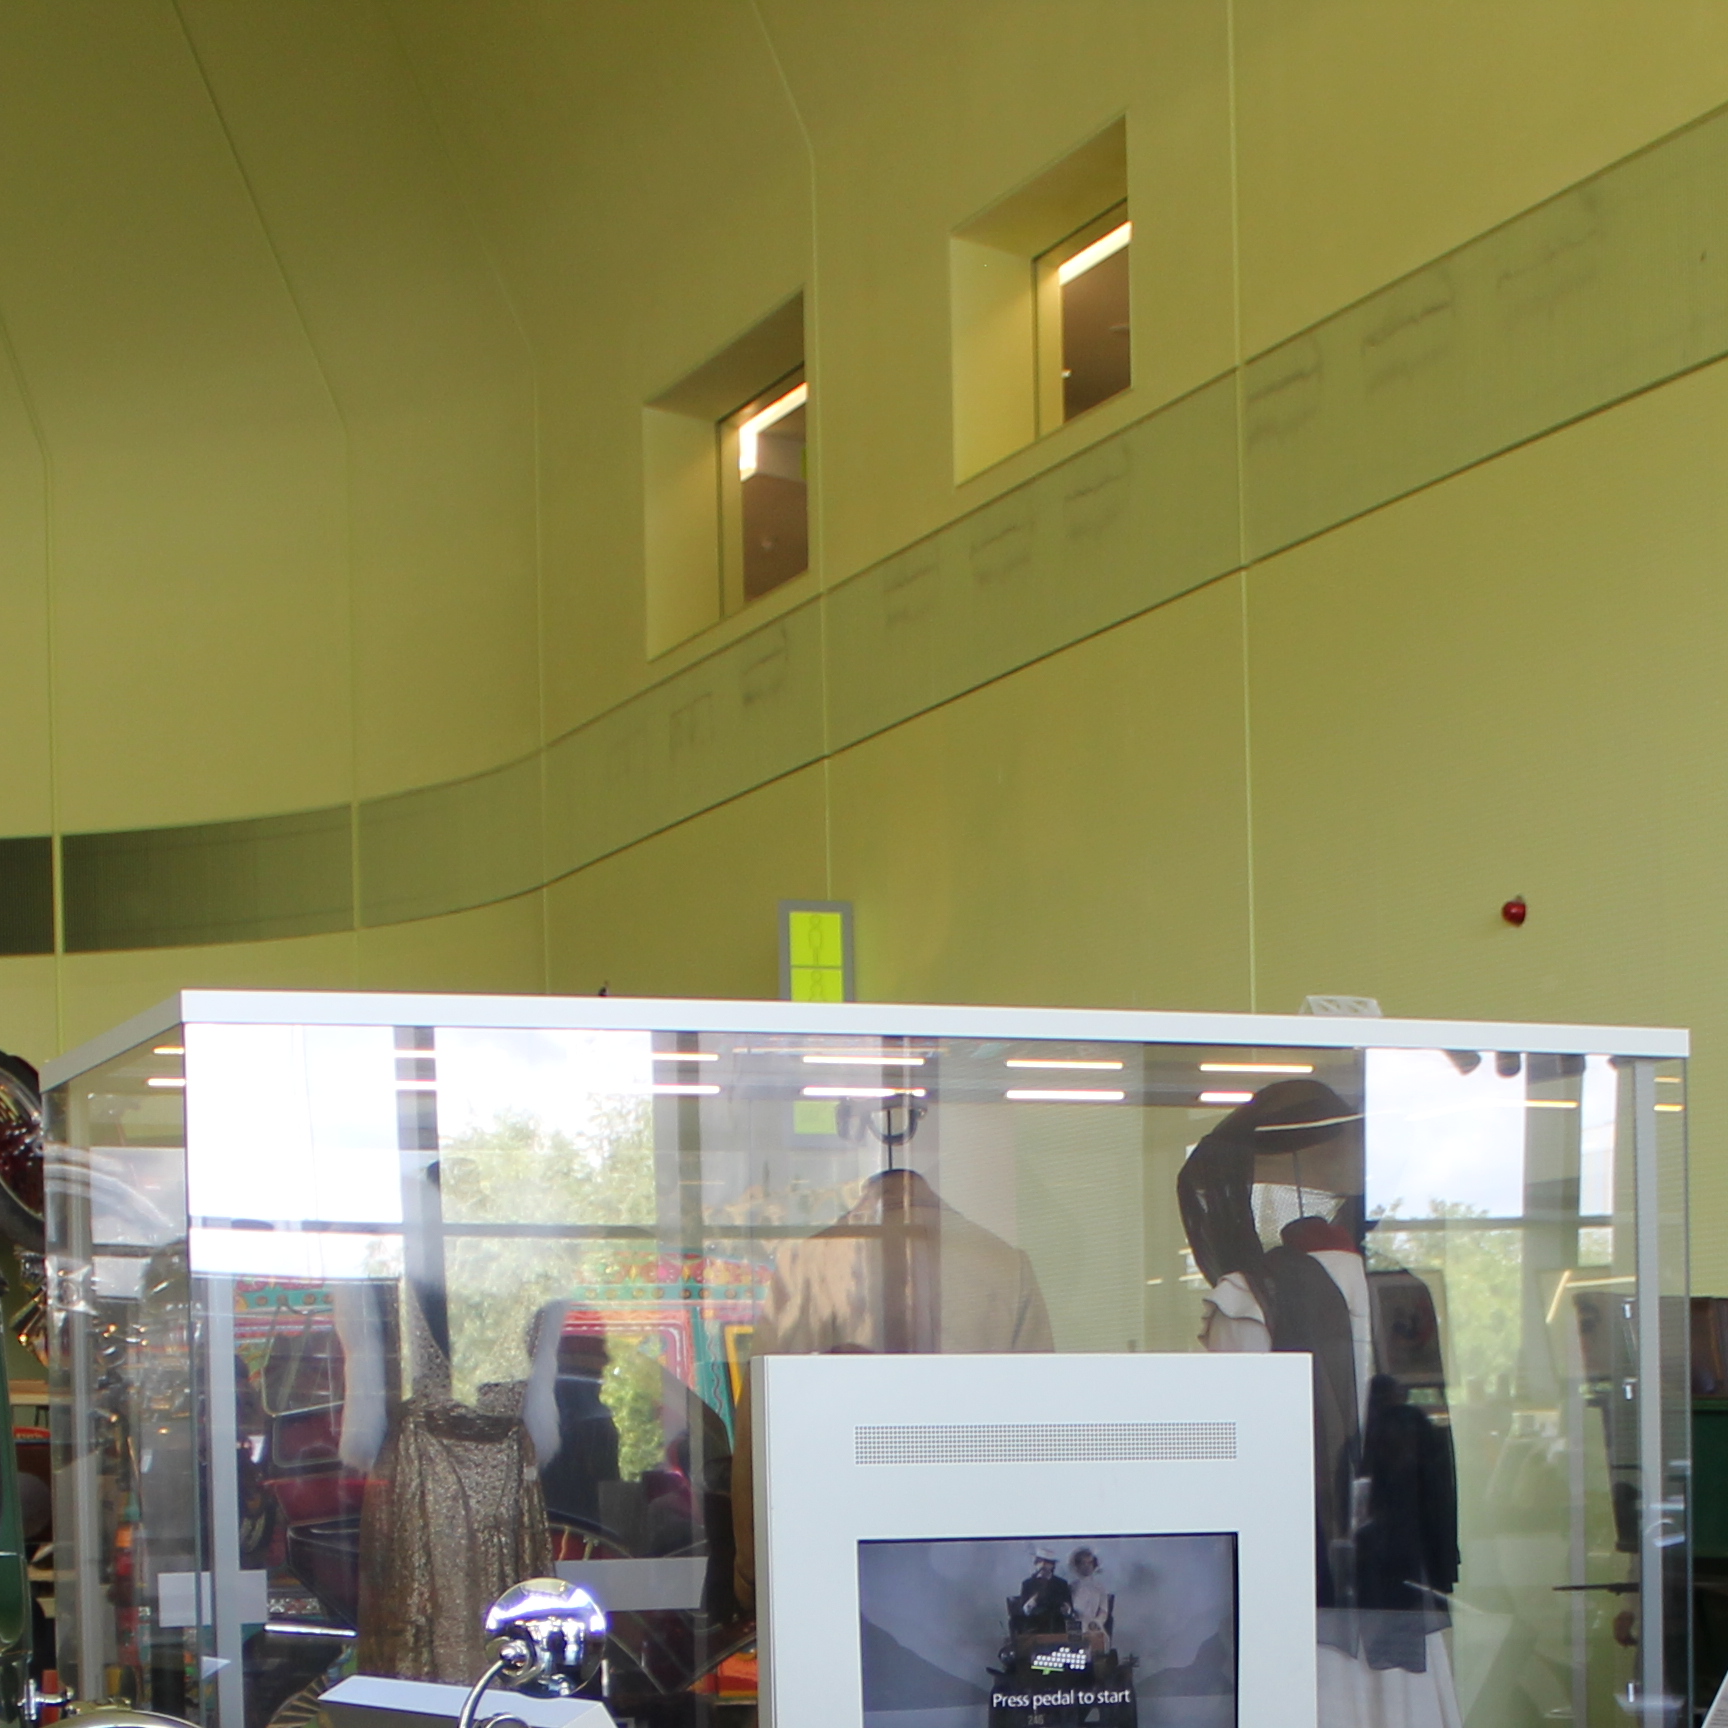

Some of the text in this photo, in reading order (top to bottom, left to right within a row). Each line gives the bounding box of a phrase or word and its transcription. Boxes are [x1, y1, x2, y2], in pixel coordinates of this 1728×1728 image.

[993, 1689, 1130, 1710] Press pedal to start
